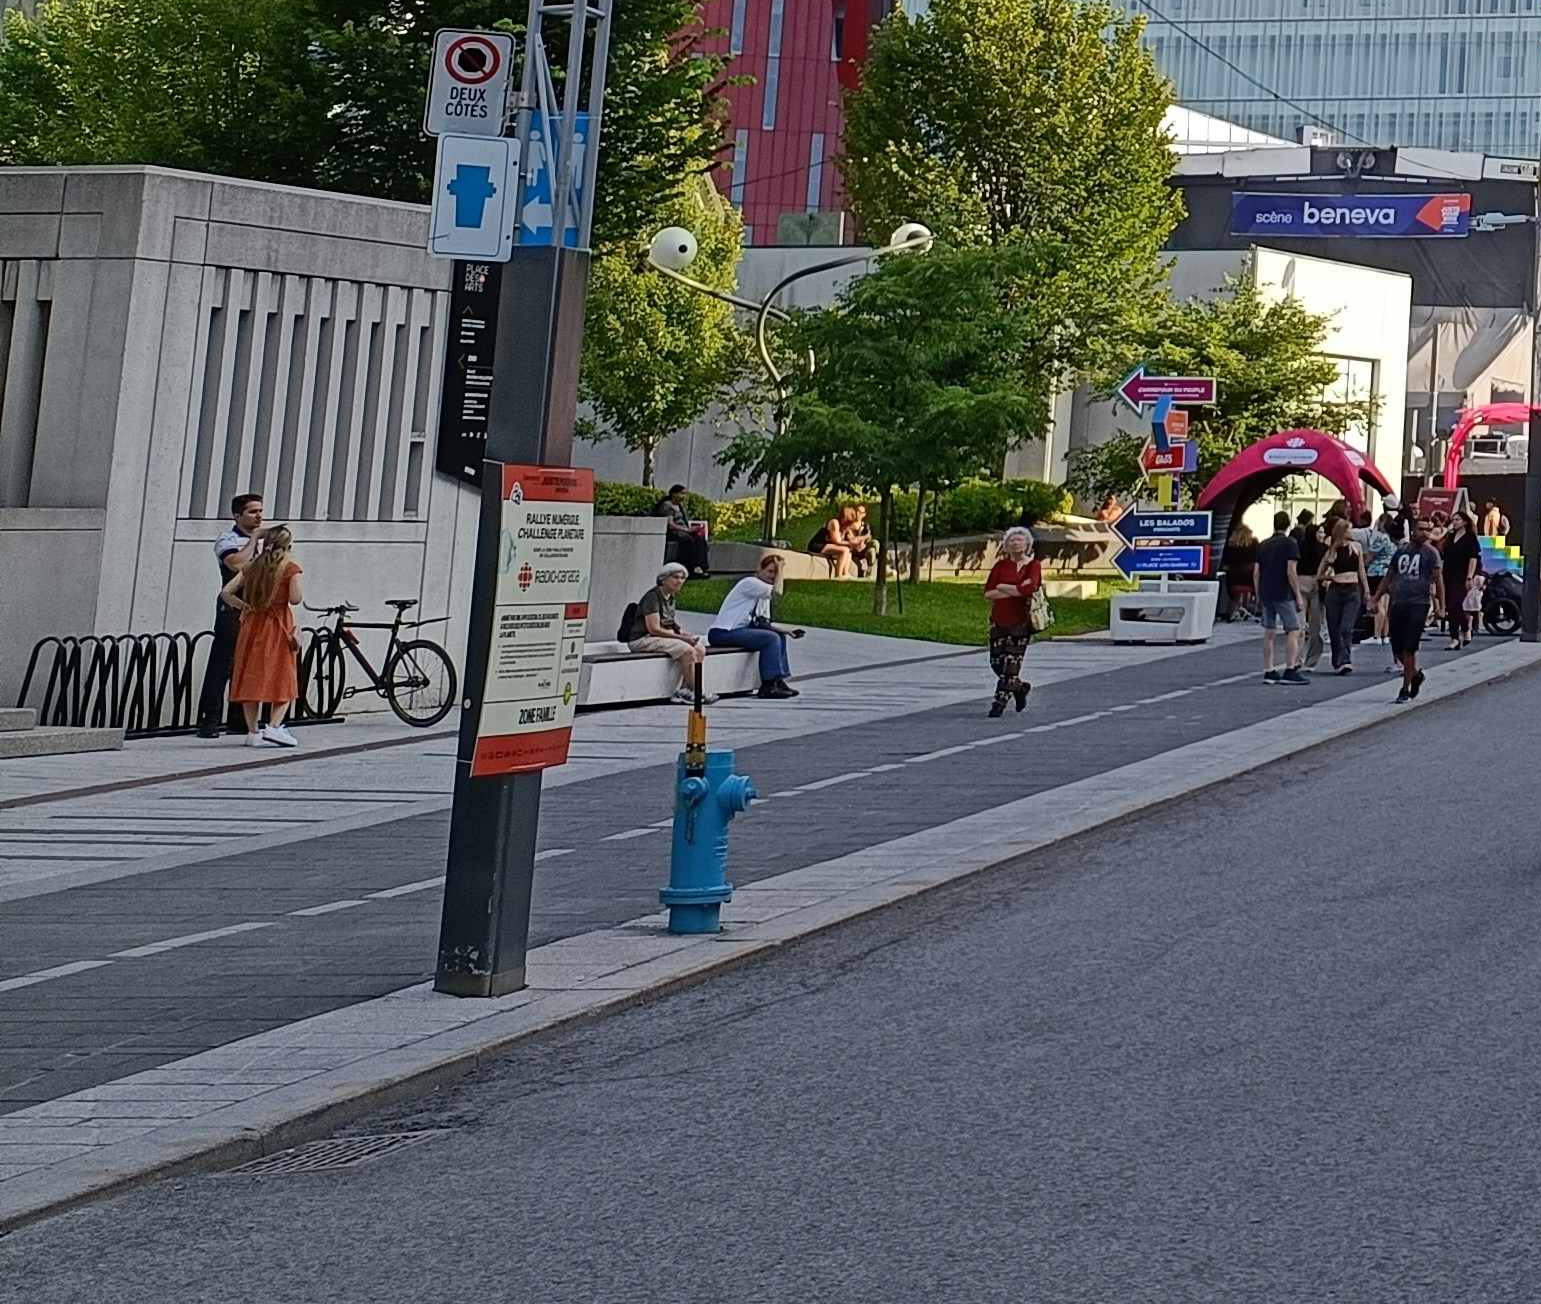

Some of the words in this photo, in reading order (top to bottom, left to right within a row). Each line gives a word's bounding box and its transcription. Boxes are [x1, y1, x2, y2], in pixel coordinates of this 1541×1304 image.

[450, 86, 487, 102] DEUX
[445, 100, 488, 118] CÔTÉS
[1255, 210, 1293, 224] scène
[1303, 201, 1396, 225] beneva
[466, 263, 490, 275] PLACE
[465, 272, 480, 283] DES
[464, 282, 484, 293] ARTS
[526, 513, 552, 526] RALLYE
[1139, 519, 1155, 527] LES
[1156, 518, 1195, 527] BALADOS
[517, 527, 556, 540] CHALLENGE
[518, 708, 536, 725] ZONE
[536, 705, 557, 723] FAMILLE
